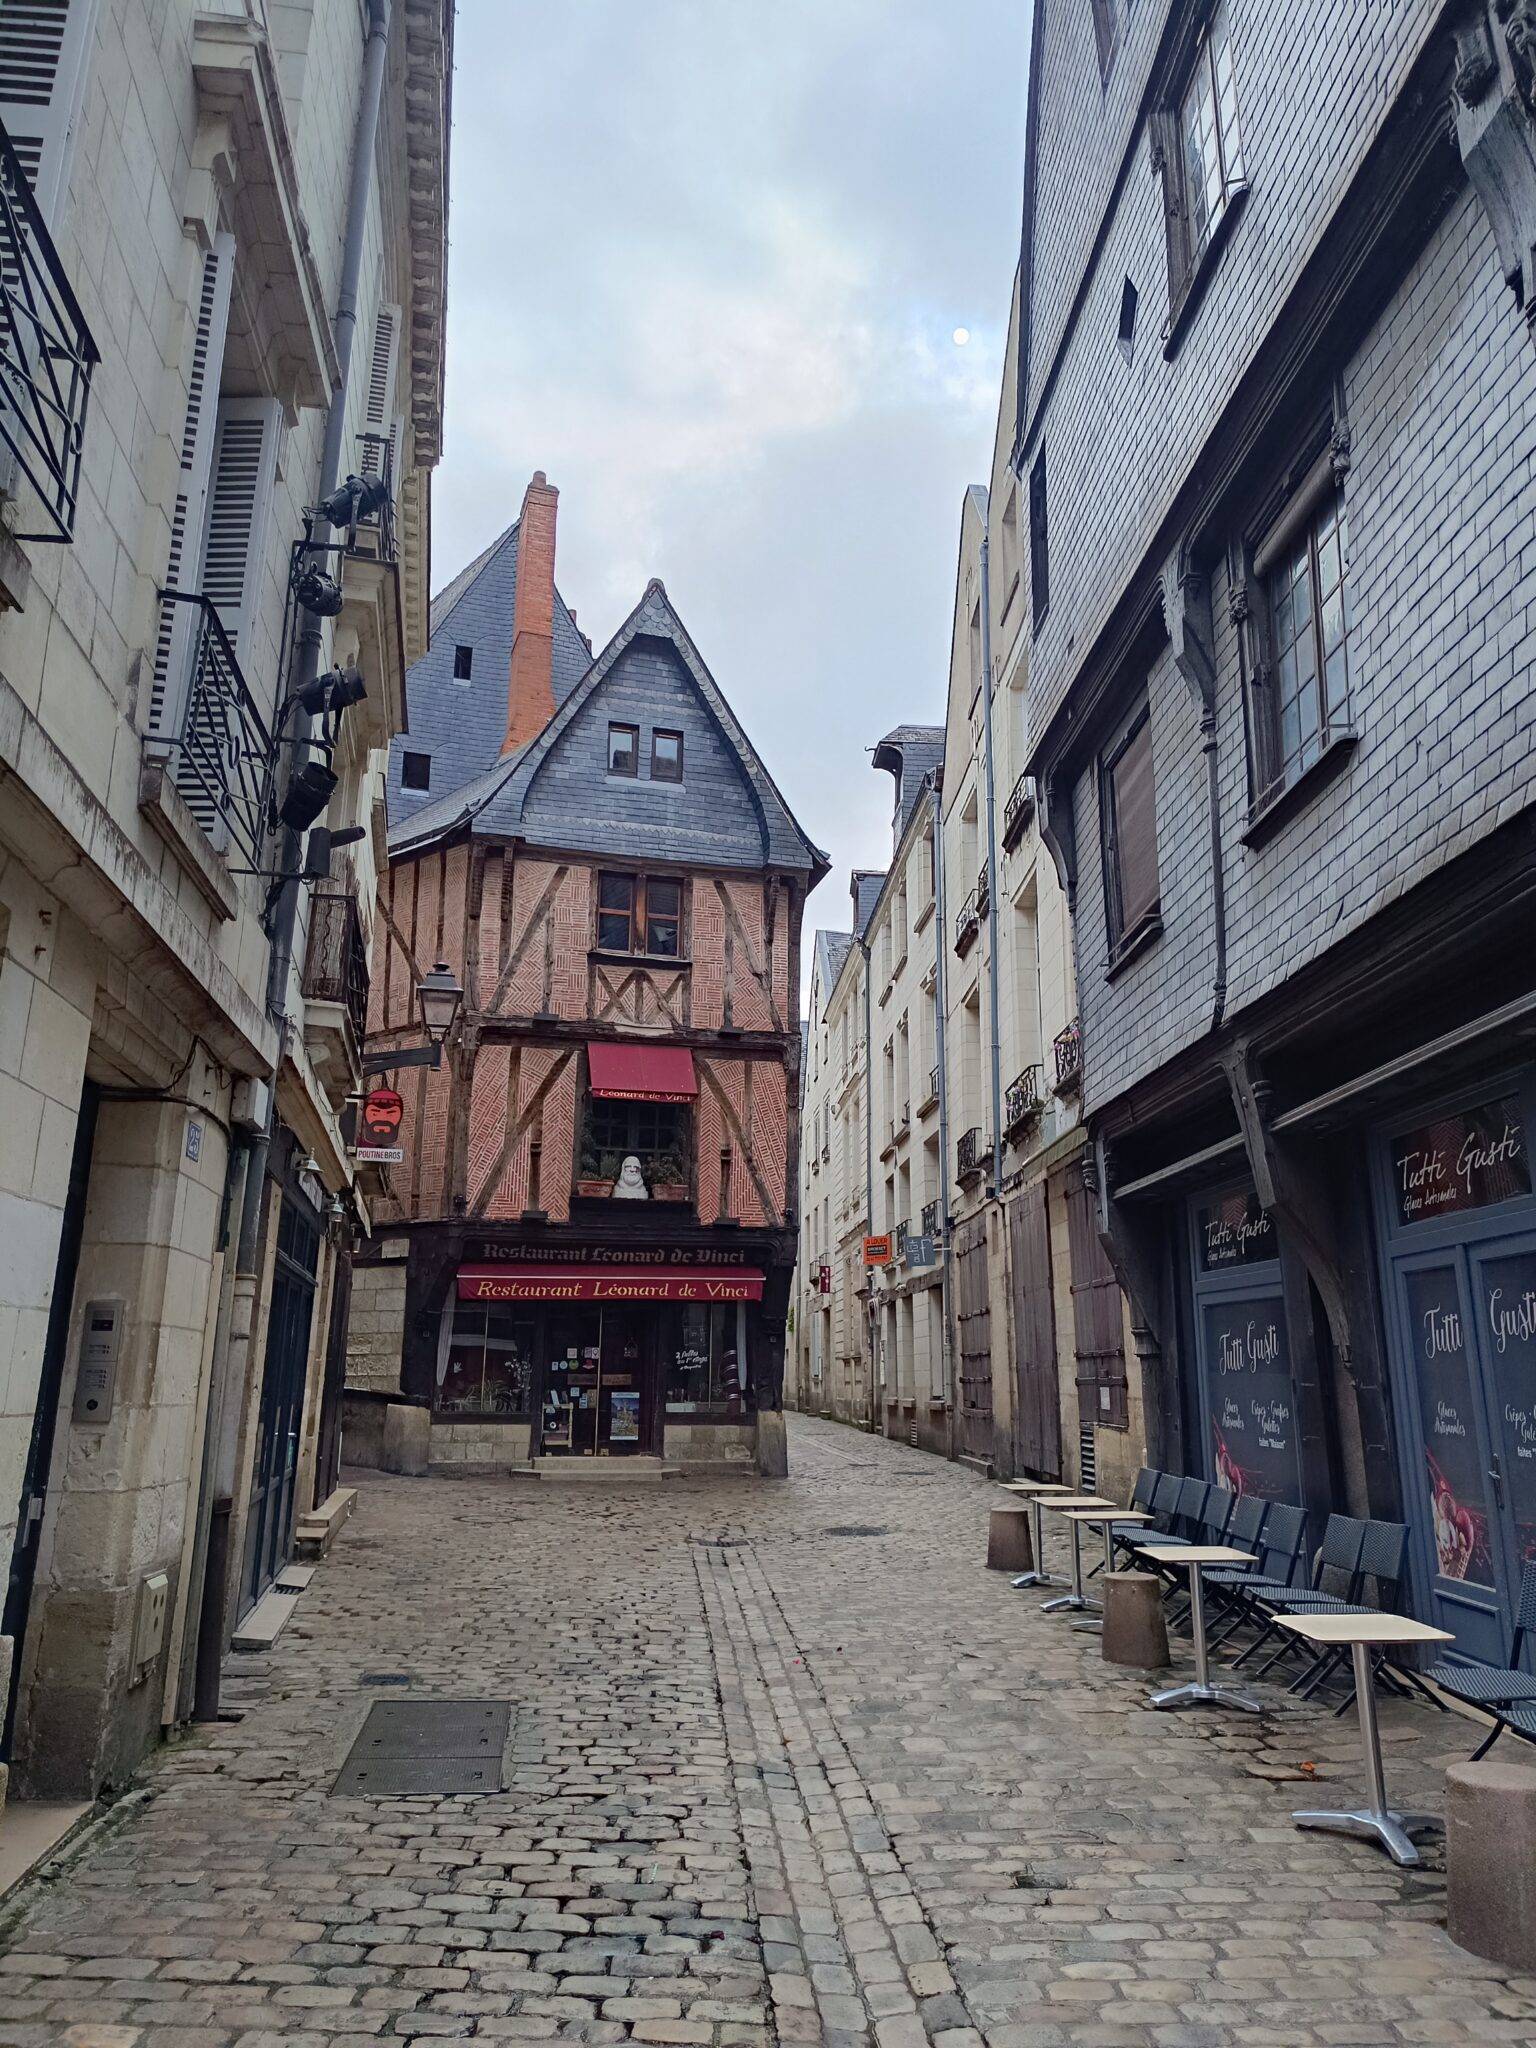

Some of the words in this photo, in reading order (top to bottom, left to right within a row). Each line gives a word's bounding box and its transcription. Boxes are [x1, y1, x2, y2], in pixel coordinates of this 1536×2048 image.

[358, 1150, 383, 1159] POUTINE
[384, 1151, 401, 1160] BROS
[1397, 1150, 1446, 1191] Tutti
[1456, 1125, 1520, 1195] Gusti
[1403, 1195, 1422, 1219] Glaces
[1205, 1221, 1232, 1247] Tutti
[1236, 1210, 1271, 1255] Gusti
[482, 1243, 587, 1261] Restaurant
[670, 1248, 693, 1263] de
[696, 1249, 745, 1263] Vinci
[477, 1281, 582, 1297] Restaurant
[592, 1281, 669, 1297] Léonard
[678, 1283, 697, 1297] de
[705, 1282, 748, 1297] Vinci
[1423, 1302, 1463, 1359] Tutti
[1219, 1329, 1243, 1375] Tutti
[1247, 1320, 1279, 1374] Gusti
[1437, 1400, 1457, 1420] Glaces
